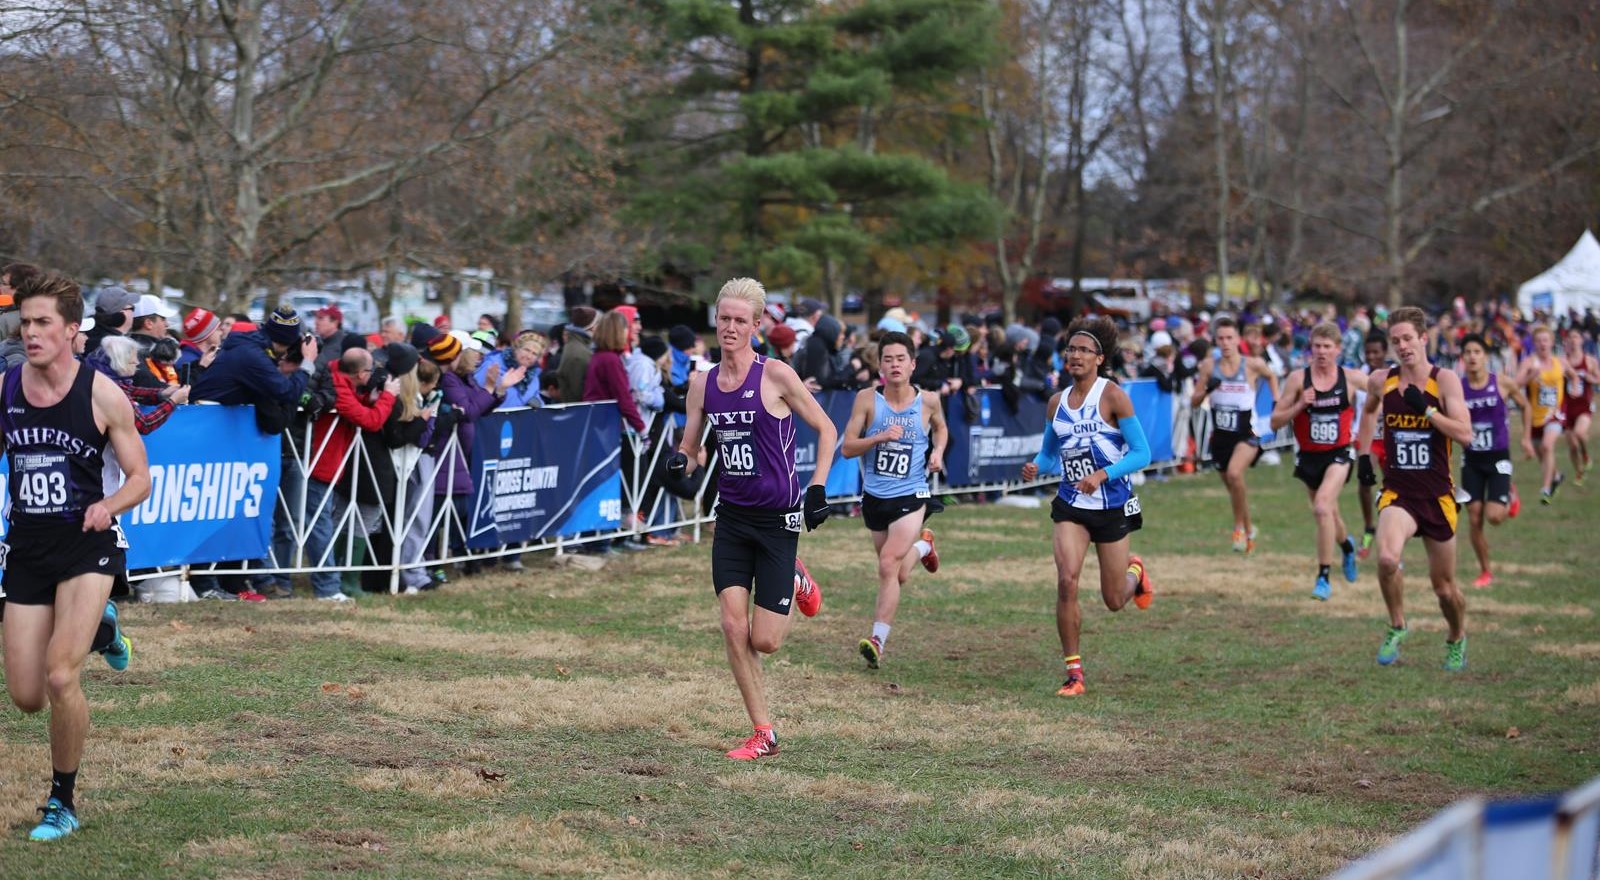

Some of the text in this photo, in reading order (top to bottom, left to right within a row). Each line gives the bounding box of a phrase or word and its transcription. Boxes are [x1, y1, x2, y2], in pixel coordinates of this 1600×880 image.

[708, 411, 756, 426] NYU
[882, 416, 915, 428] JOHNS
[1073, 423, 1098, 435] CNU
[6, 428, 98, 459] MHERST
[1310, 422, 1339, 442] 696
[721, 443, 754, 470] 646
[877, 451, 909, 475] 578
[1396, 443, 1430, 465] 516
[1064, 458, 1096, 482] 536
[19, 471, 67, 507] 493
[131, 462, 268, 524] ONSHIPS
